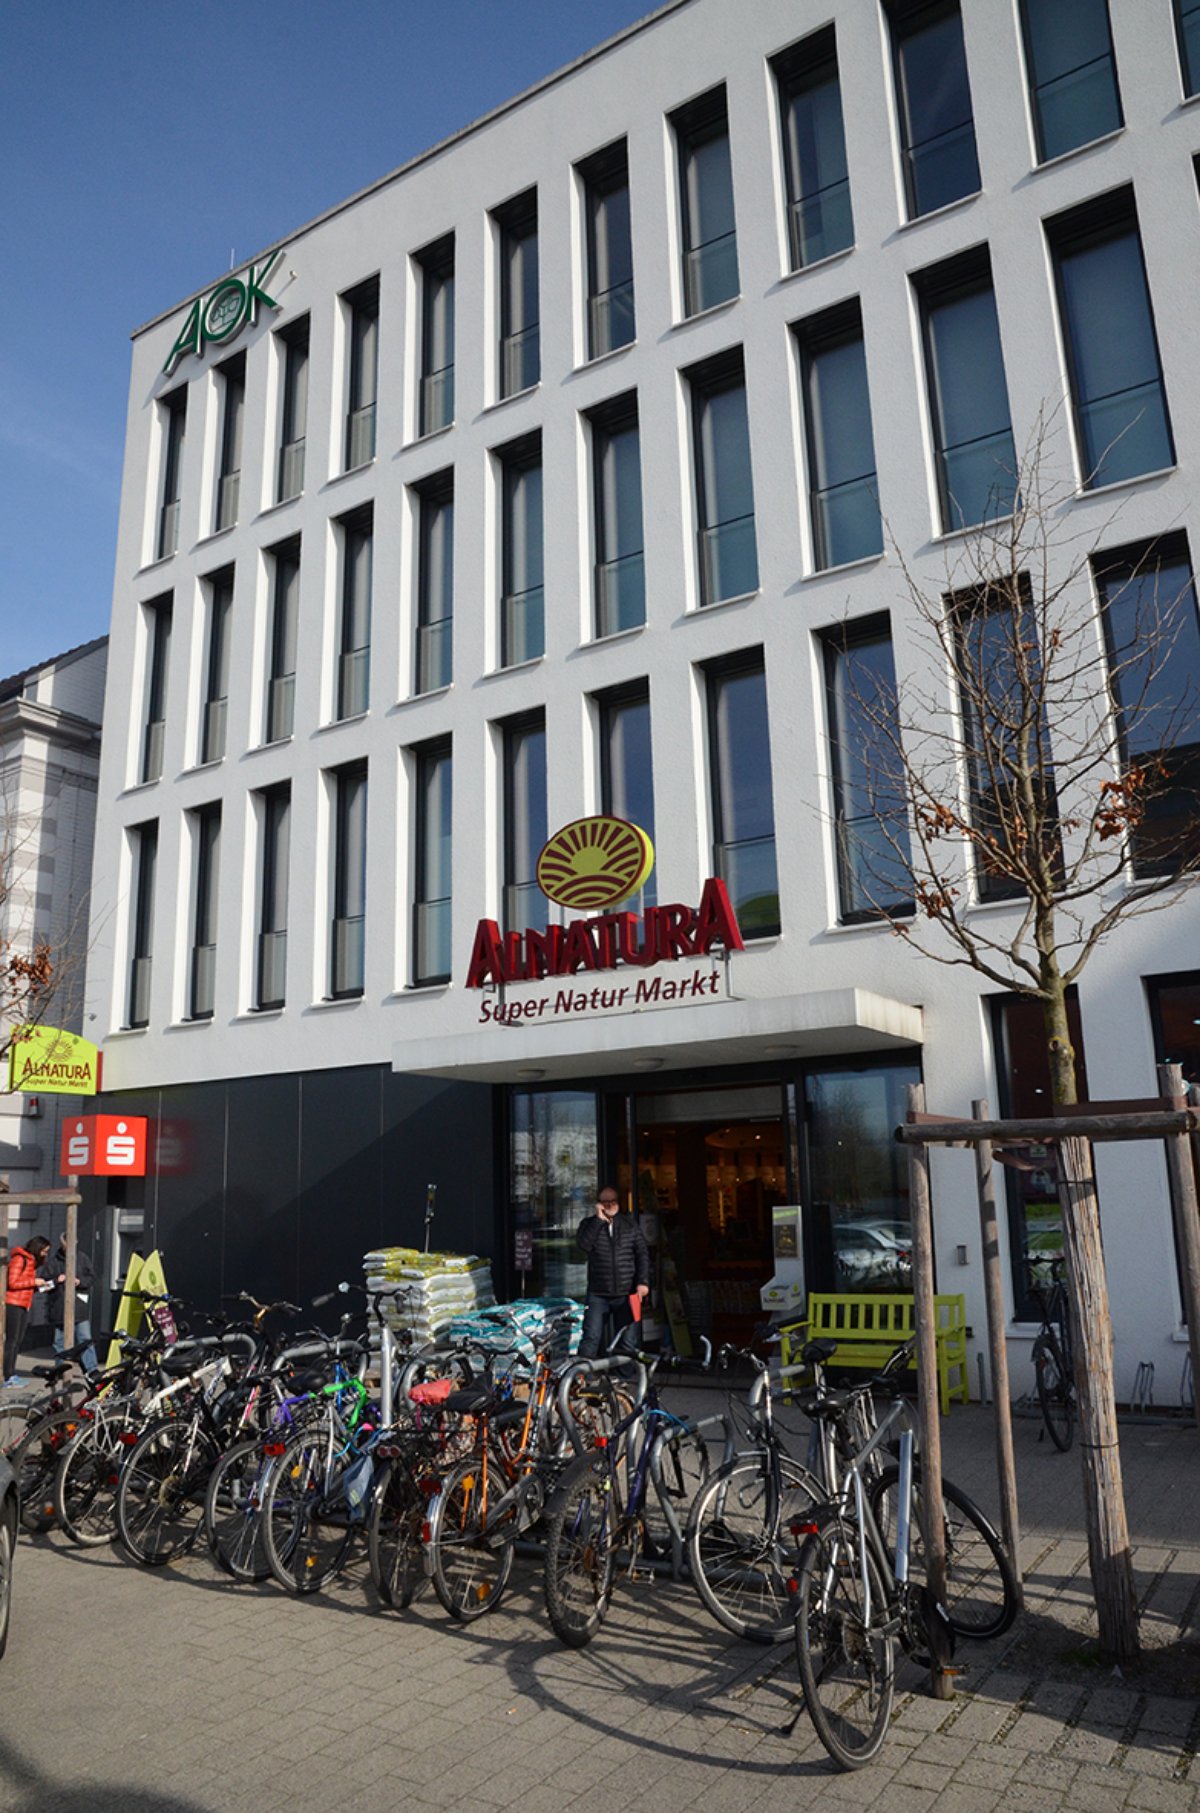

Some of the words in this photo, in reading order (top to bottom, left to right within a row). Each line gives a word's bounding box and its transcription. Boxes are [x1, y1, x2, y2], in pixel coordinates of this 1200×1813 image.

[162, 249, 284, 377] AOK
[465, 877, 745, 989] ALNATURA
[478, 998, 549, 1026] Super
[554, 989, 630, 1015] Natur
[634, 969, 721, 1004] Markt
[22, 1056, 92, 1081] ALNATURA
